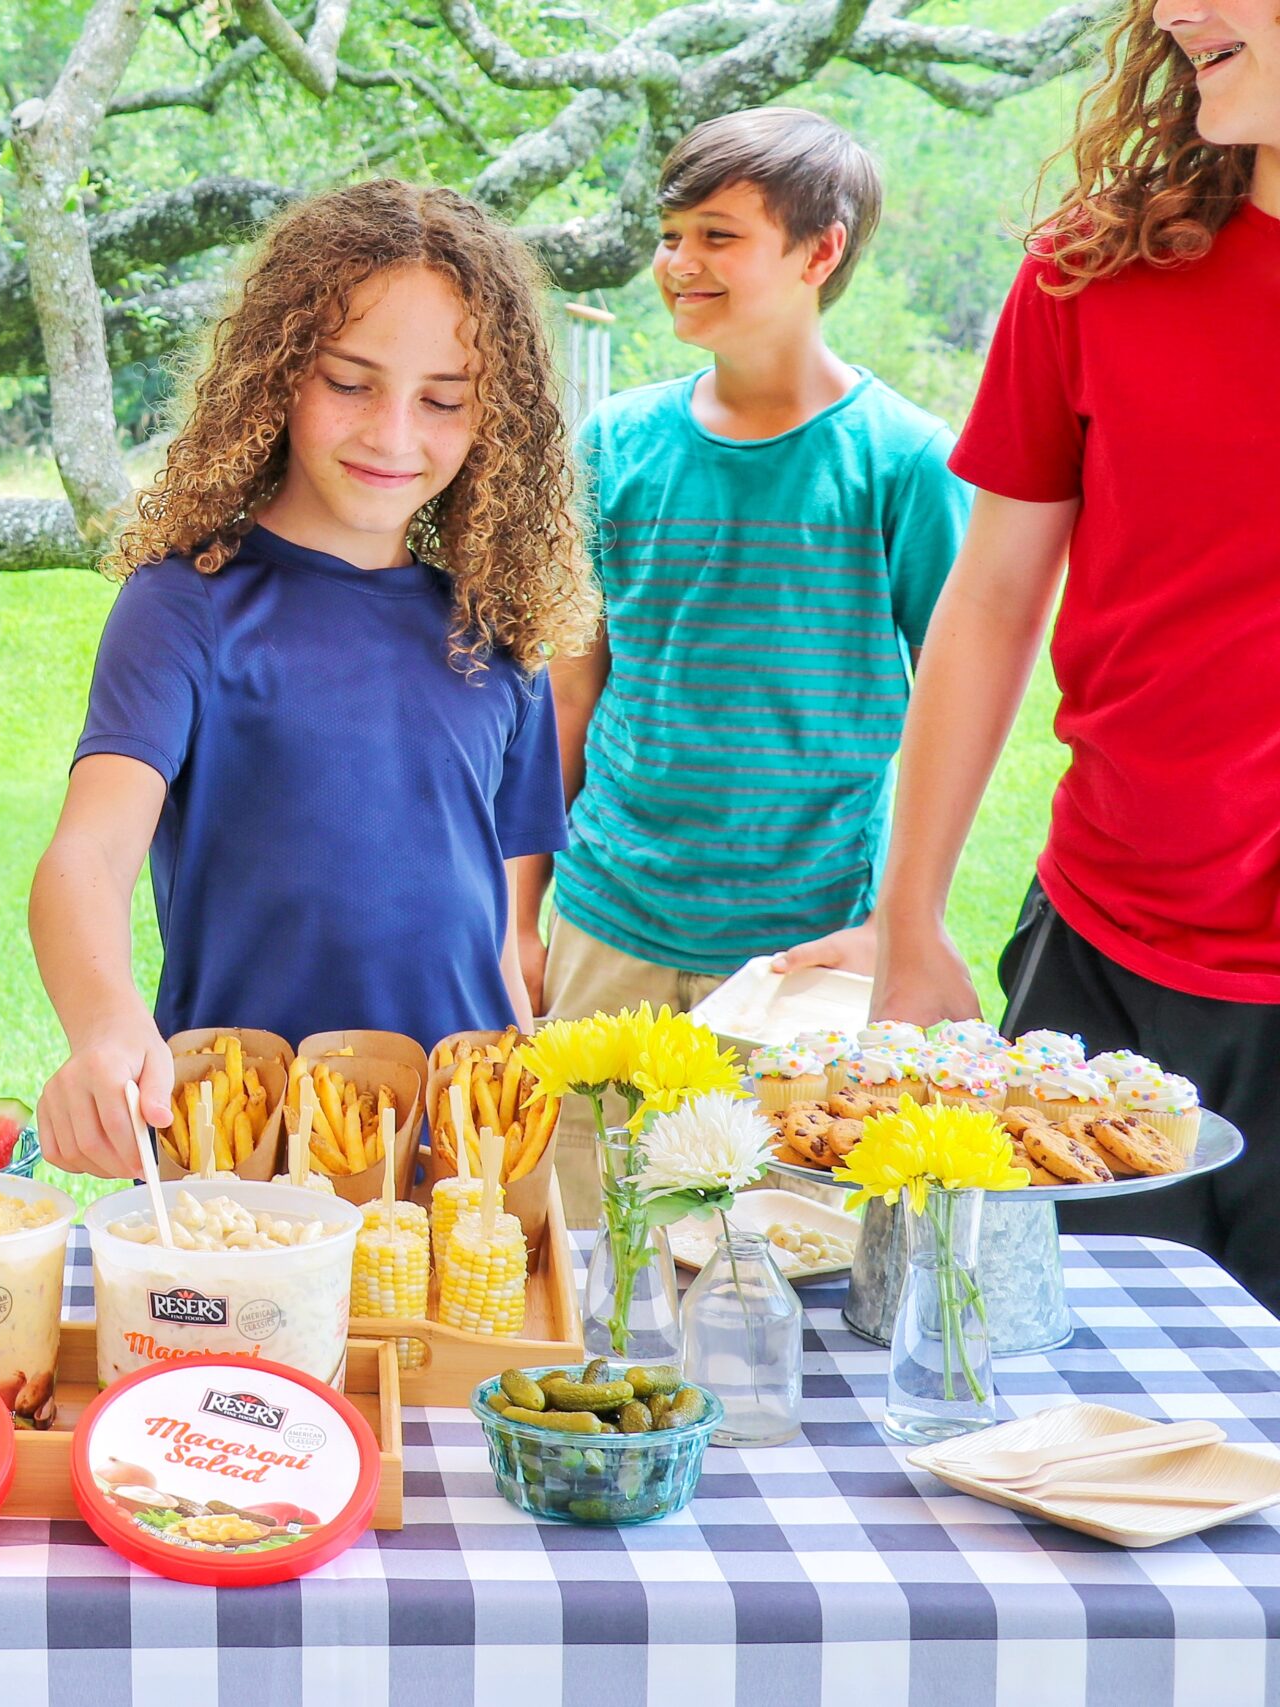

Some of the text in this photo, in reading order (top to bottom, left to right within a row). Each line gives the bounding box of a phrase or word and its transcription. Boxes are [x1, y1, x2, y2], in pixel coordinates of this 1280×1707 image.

[153, 1294, 224, 1322] RESER'S
[240, 1307, 276, 1322] AMERICAN
[243, 1318, 276, 1333] CLASSICS
[206, 1392, 281, 1427] RESER'S
[144, 1416, 313, 1470] Macaroni
[288, 1430, 323, 1439] AMERICAN
[288, 1437, 321, 1446] CLASSICS
[164, 1444, 271, 1483] Salad
